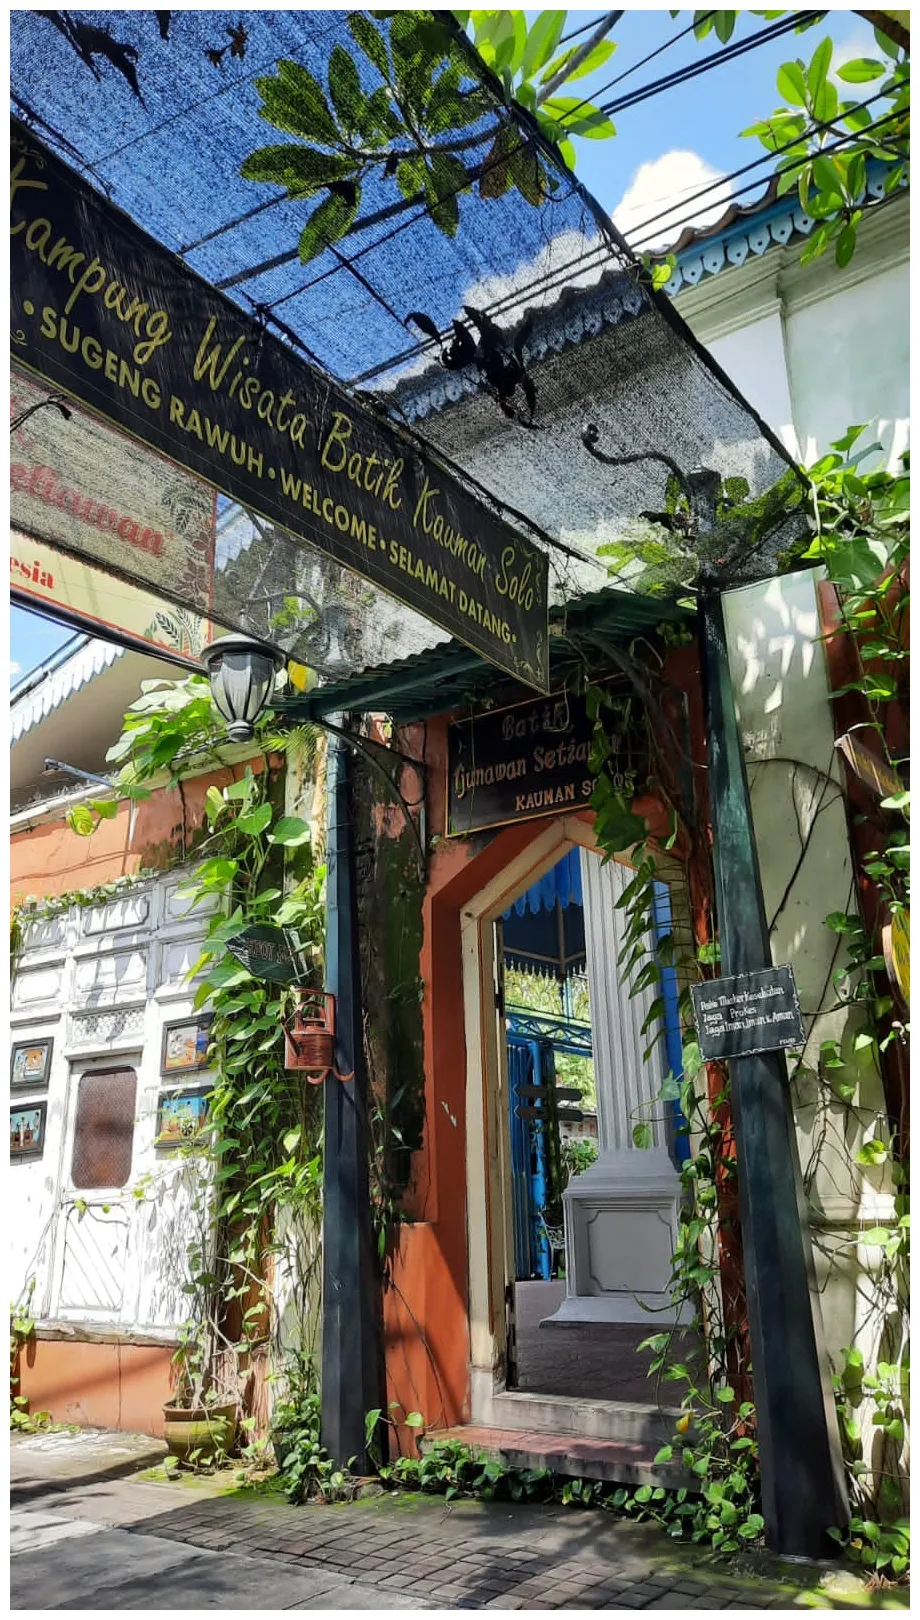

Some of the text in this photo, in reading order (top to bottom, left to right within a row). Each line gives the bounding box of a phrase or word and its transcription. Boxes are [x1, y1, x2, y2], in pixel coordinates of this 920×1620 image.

[40, 306, 511, 644] SUGENG RAWUH WELCOME SELAMAT DATANG
[193, 315, 307, 449] Wisata
[321, 411, 405, 510] Batik
[413, 476, 487, 583] Kauman
[495, 546, 534, 611] Solo
[515, 783, 575, 811] KAUMAN
